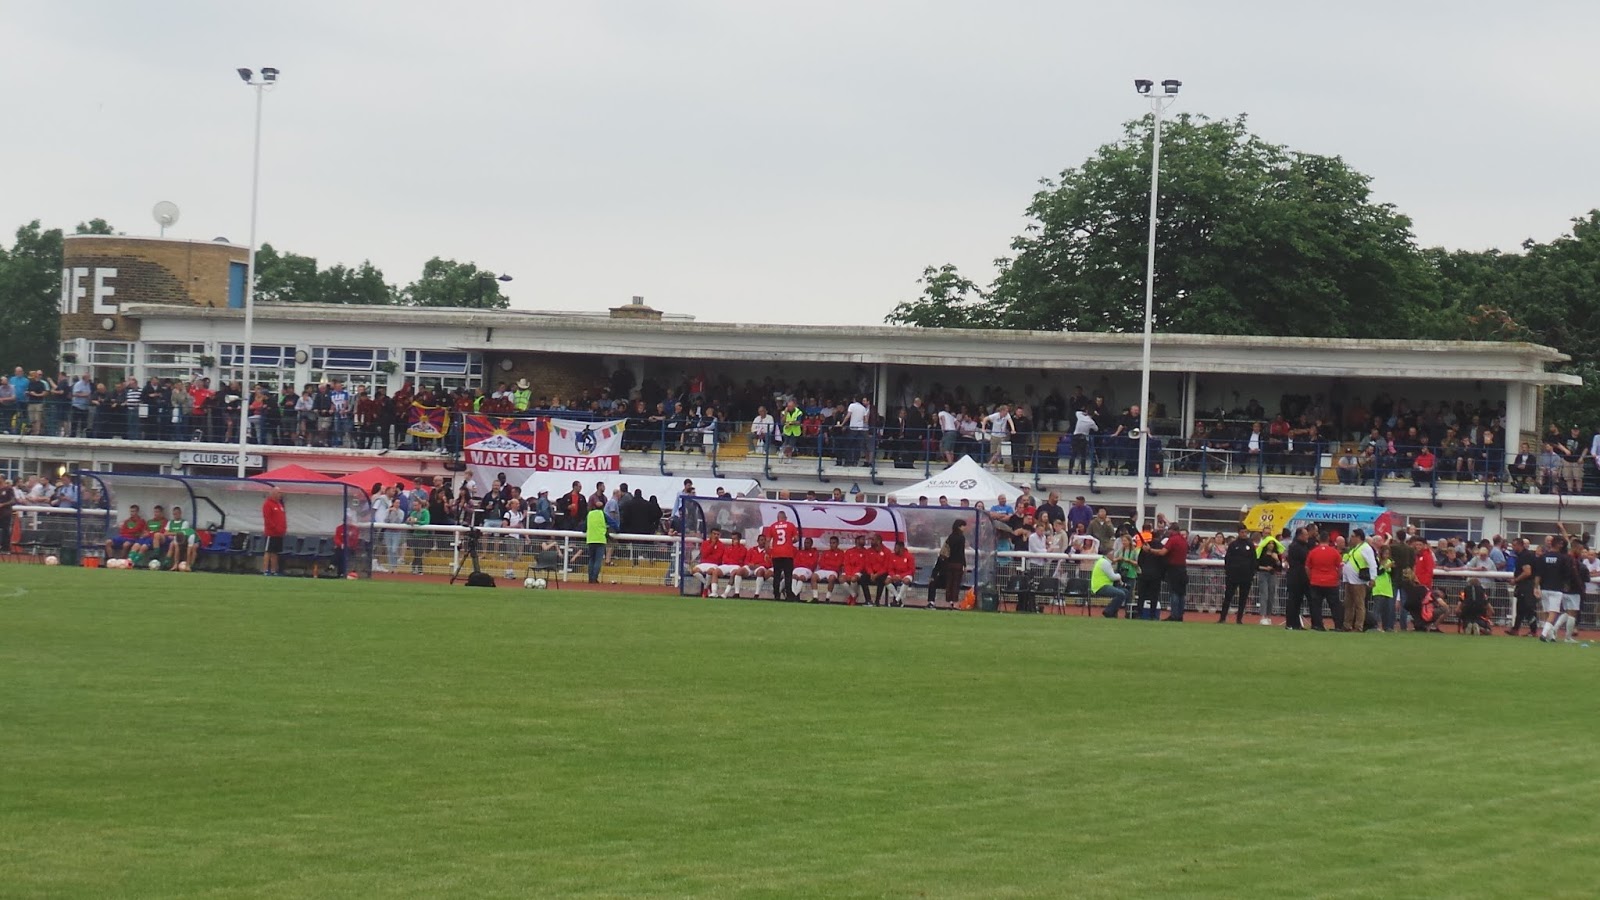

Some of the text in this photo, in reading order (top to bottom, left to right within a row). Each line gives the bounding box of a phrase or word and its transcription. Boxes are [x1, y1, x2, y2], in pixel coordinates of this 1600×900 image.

[193, 453, 219, 464] CLUB
[470, 450, 612, 471] MAKE US DREAM
[1323, 512, 1359, 520] WHIPPY
[776, 529, 786, 545] 3
